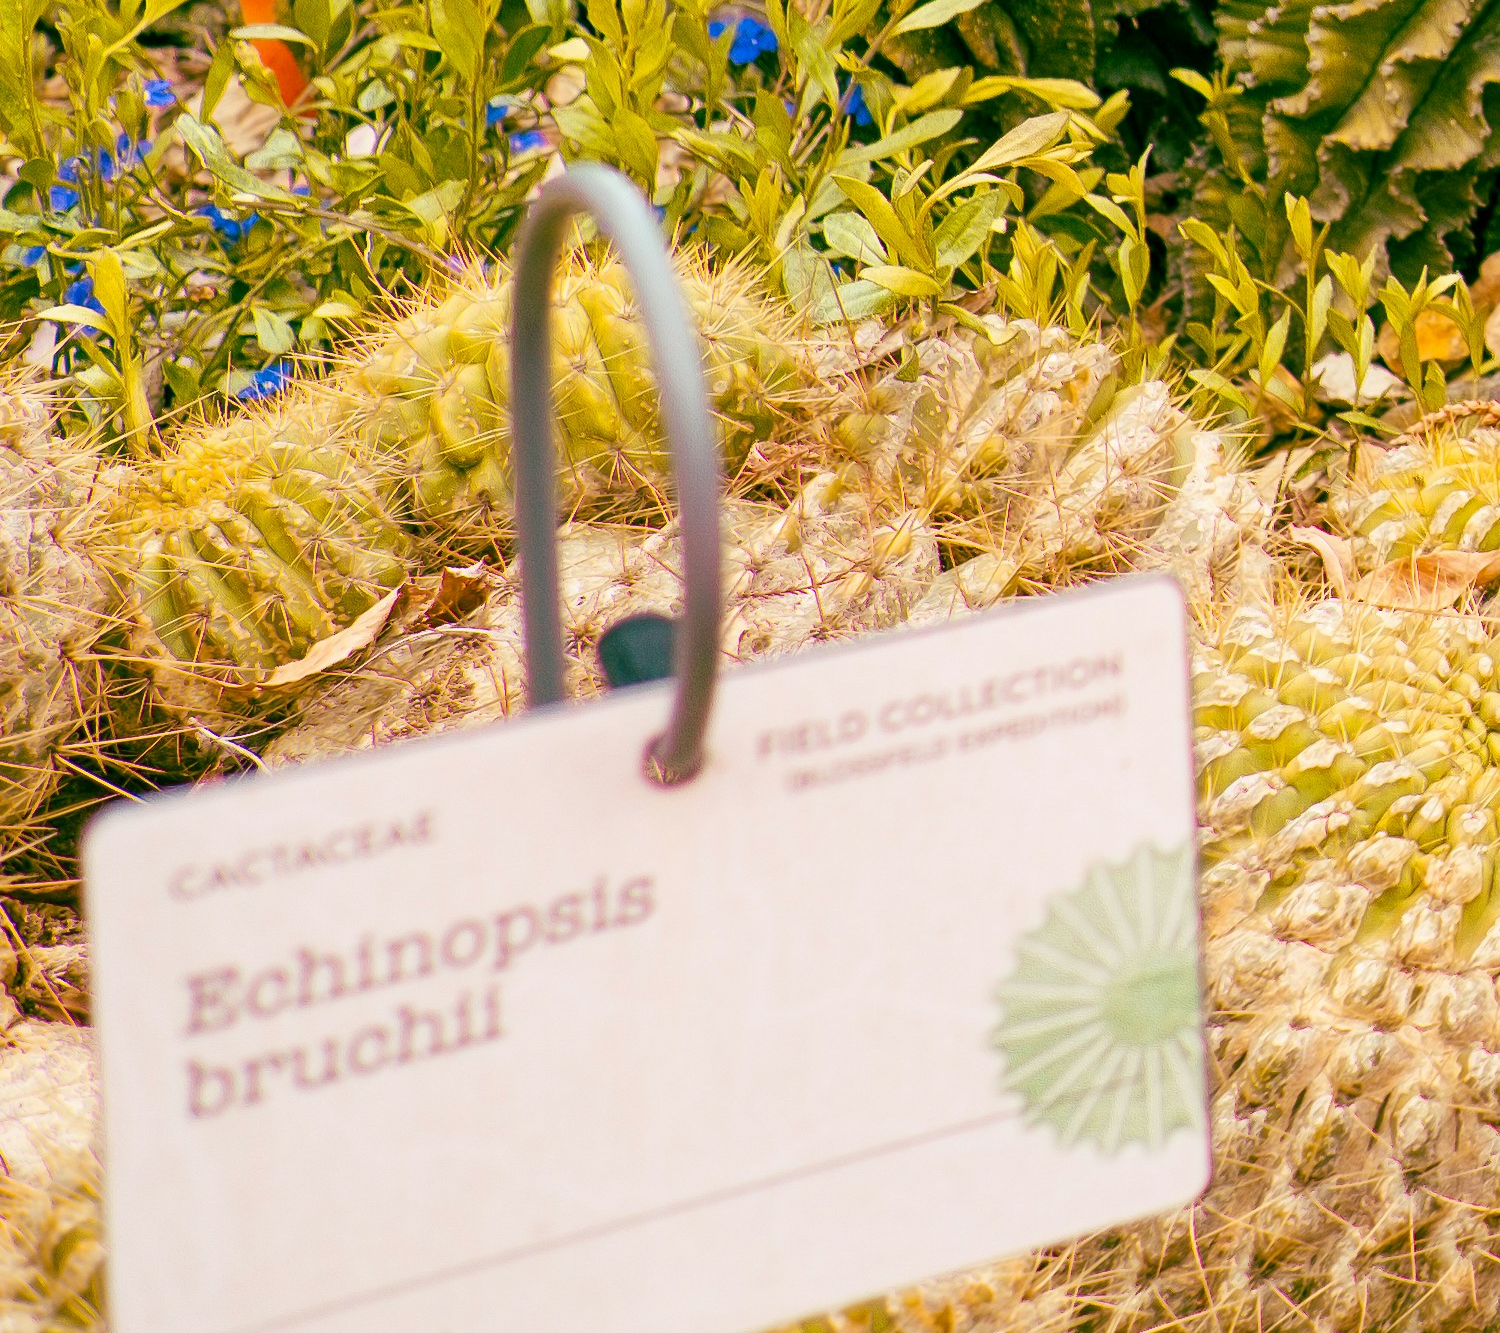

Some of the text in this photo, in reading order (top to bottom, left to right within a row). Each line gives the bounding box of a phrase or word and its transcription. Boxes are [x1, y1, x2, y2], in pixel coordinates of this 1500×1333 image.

[756, 652, 1124, 764] FIELD COLLECTION
[168, 810, 436, 902] CACTACEAE
[184, 874, 657, 1034] Echinopsis
[184, 983, 505, 1119] bruchii
